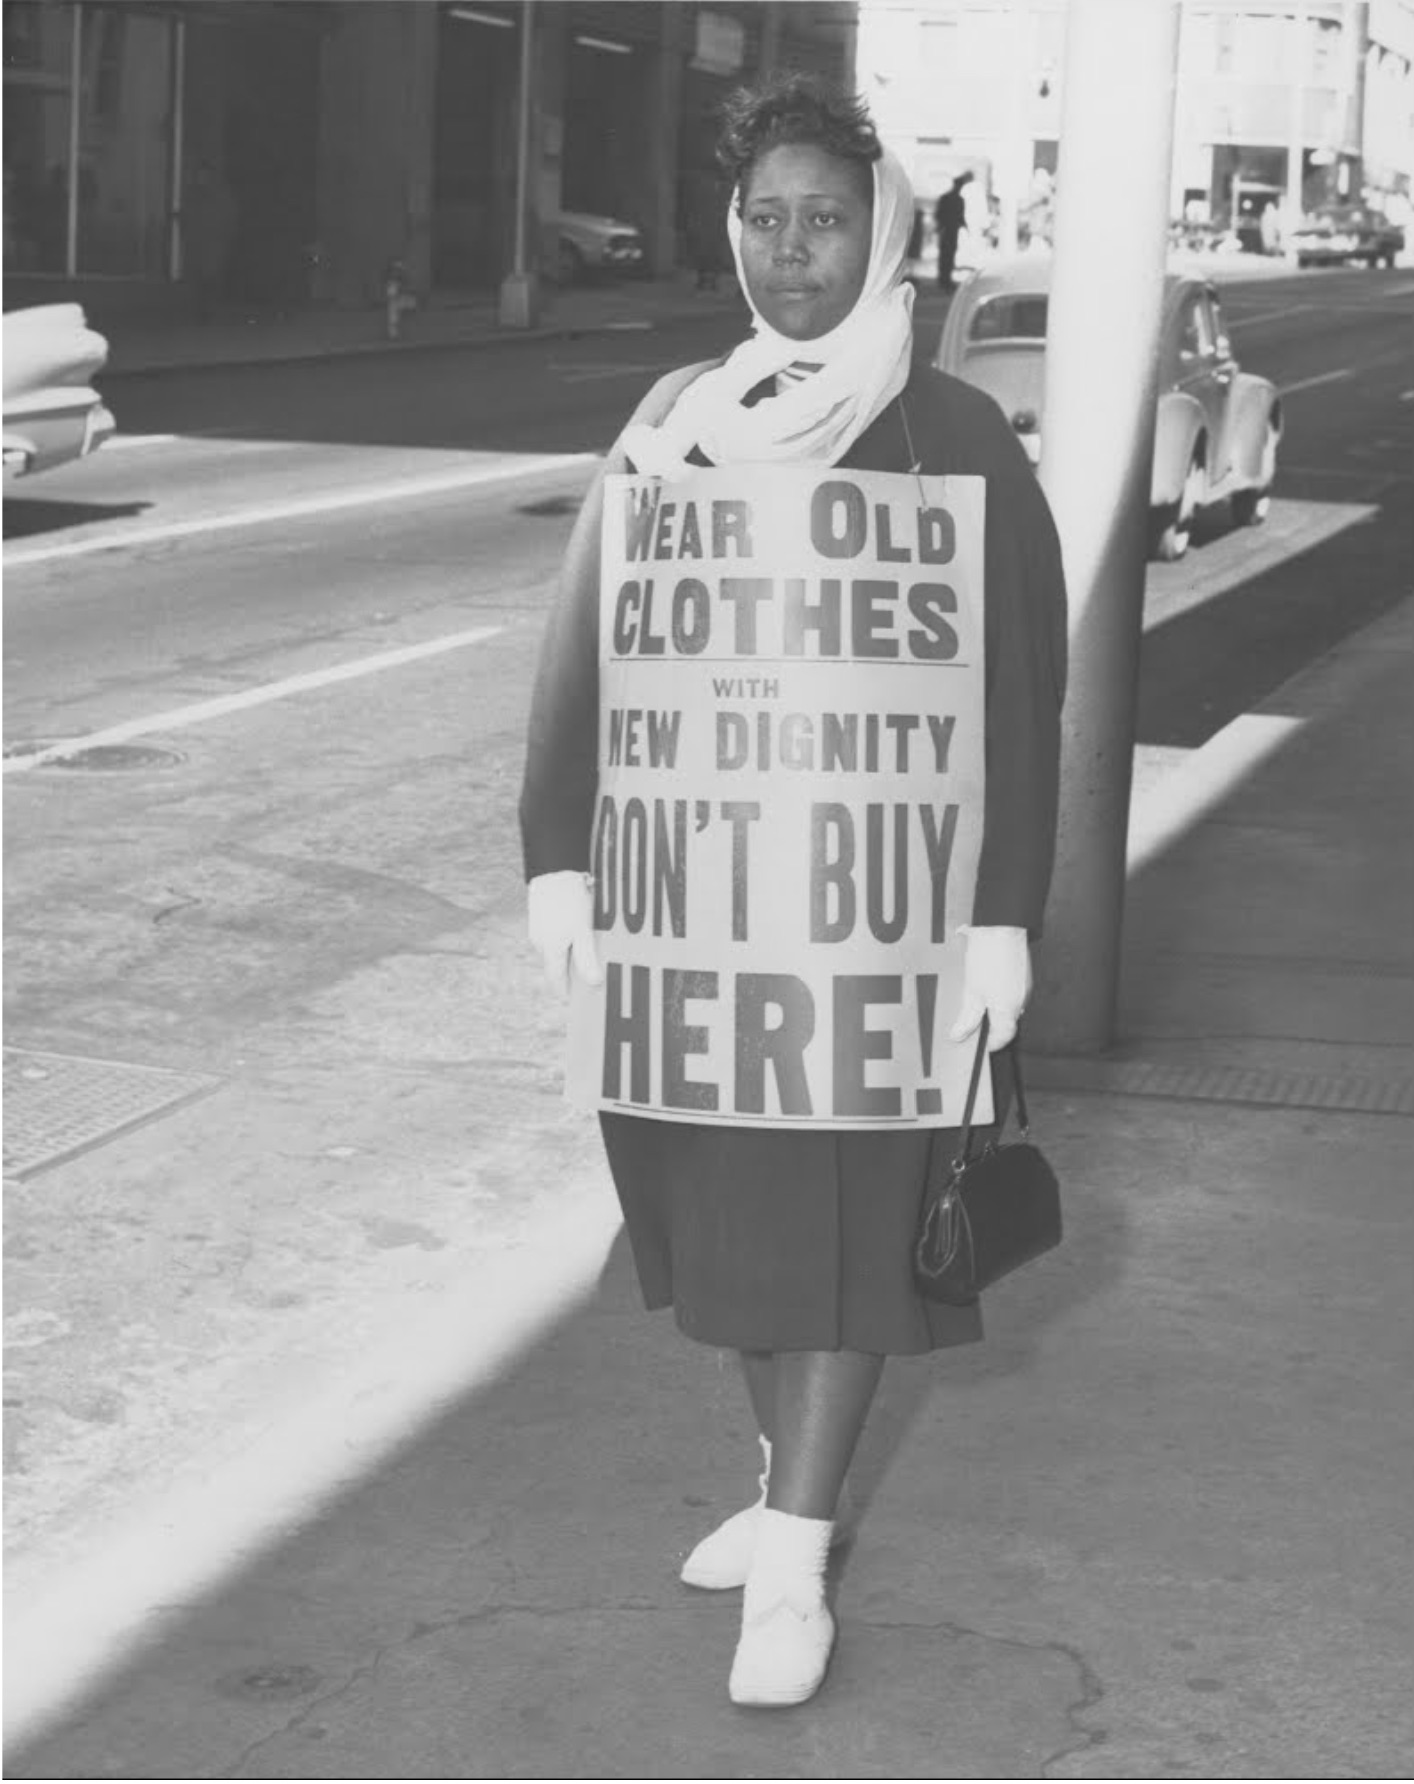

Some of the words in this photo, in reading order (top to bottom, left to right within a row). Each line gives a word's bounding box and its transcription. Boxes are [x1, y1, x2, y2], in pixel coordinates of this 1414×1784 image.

[624, 484, 754, 562] WEAR
[810, 480, 957, 565] OLD
[613, 577, 960, 660] CLOTHES
[711, 678, 779, 699] WITH
[608, 709, 682, 769] NEW
[715, 711, 957, 774] DIGNITY
[592, 795, 761, 942] DON'T
[809, 801, 960, 944] BUY
[602, 962, 943, 1117] HERE!
